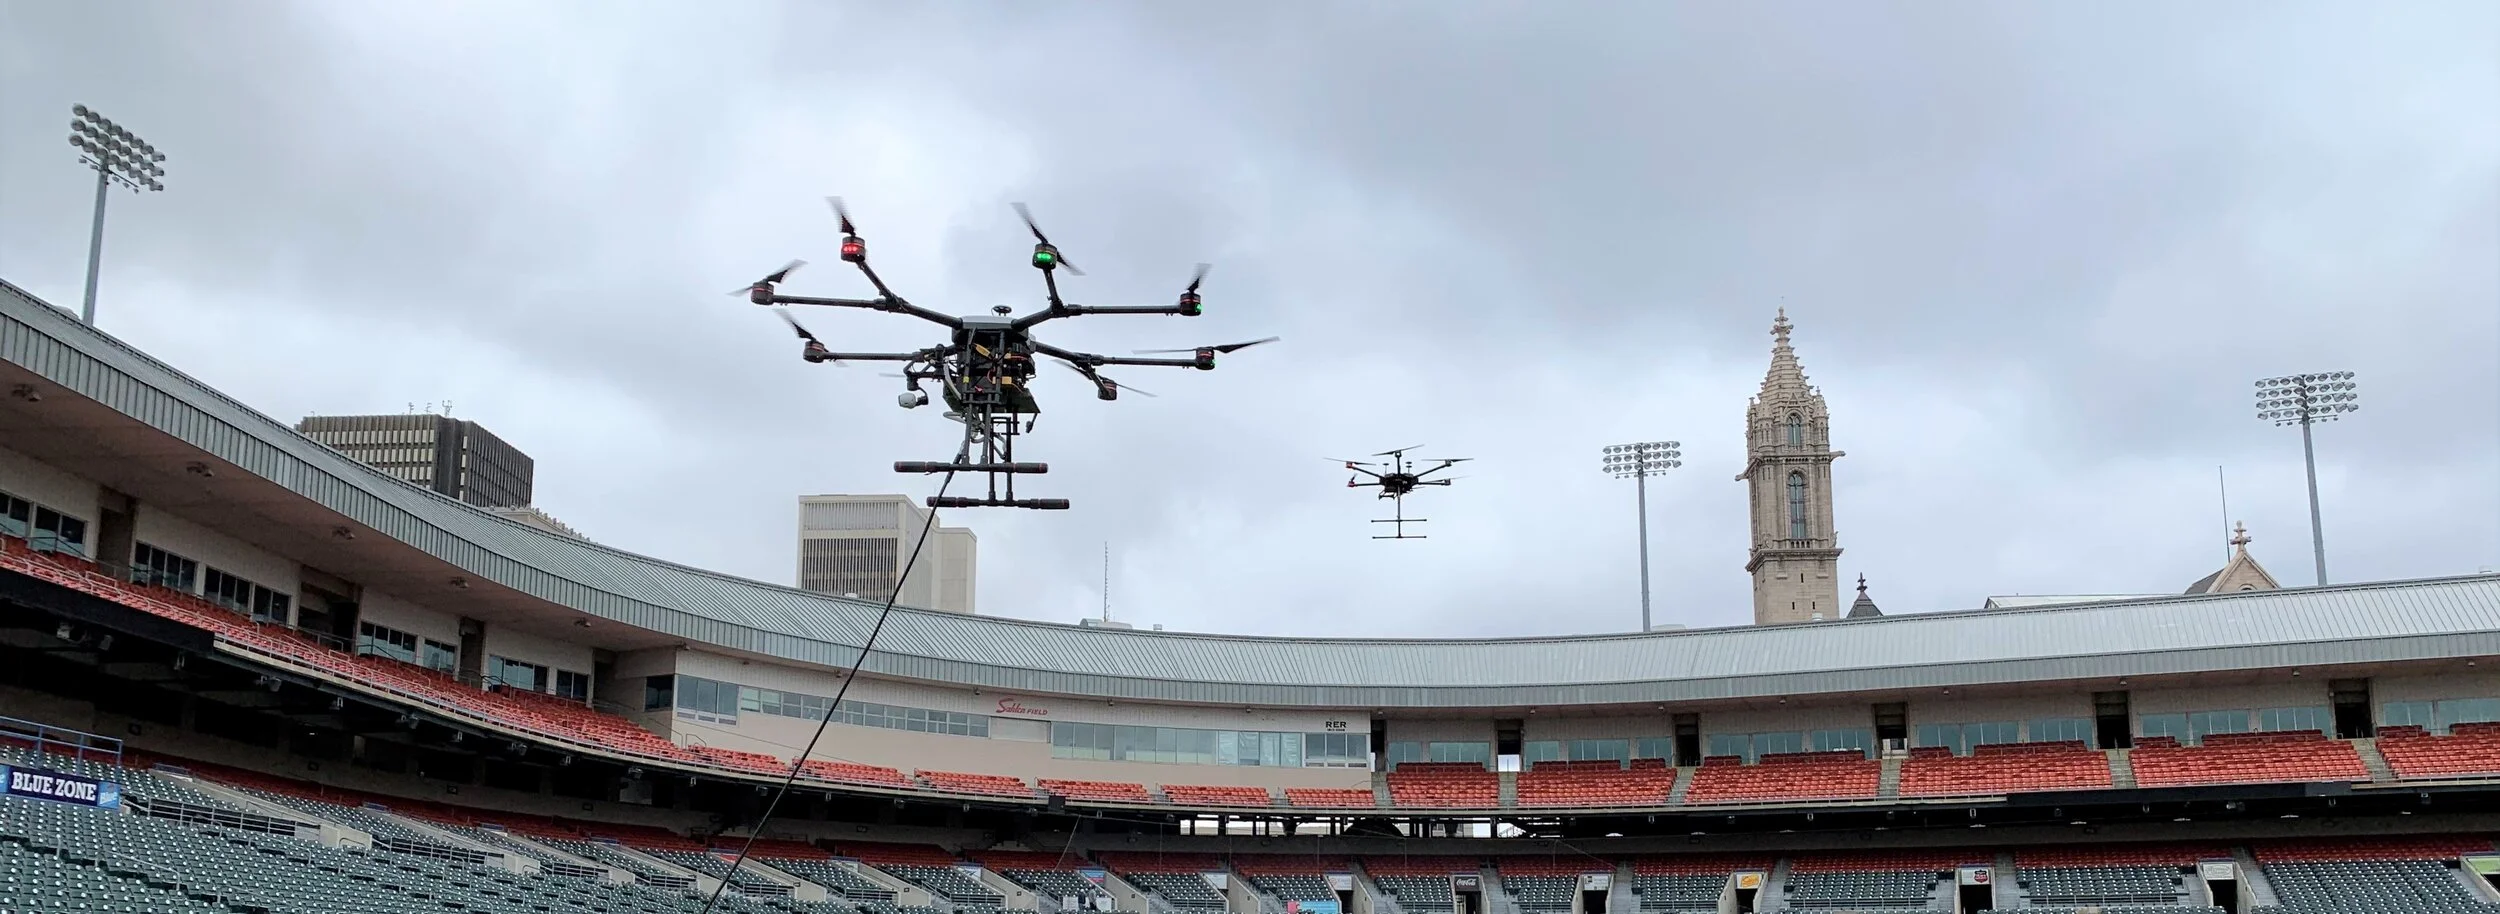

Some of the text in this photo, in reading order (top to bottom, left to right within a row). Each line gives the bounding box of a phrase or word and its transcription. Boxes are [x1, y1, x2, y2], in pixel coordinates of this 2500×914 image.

[1027, 708, 1048, 716] FIELD
[1325, 720, 1347, 729] RER
[11, 771, 54, 795] BLUE
[54, 778, 97, 801] ZONE
